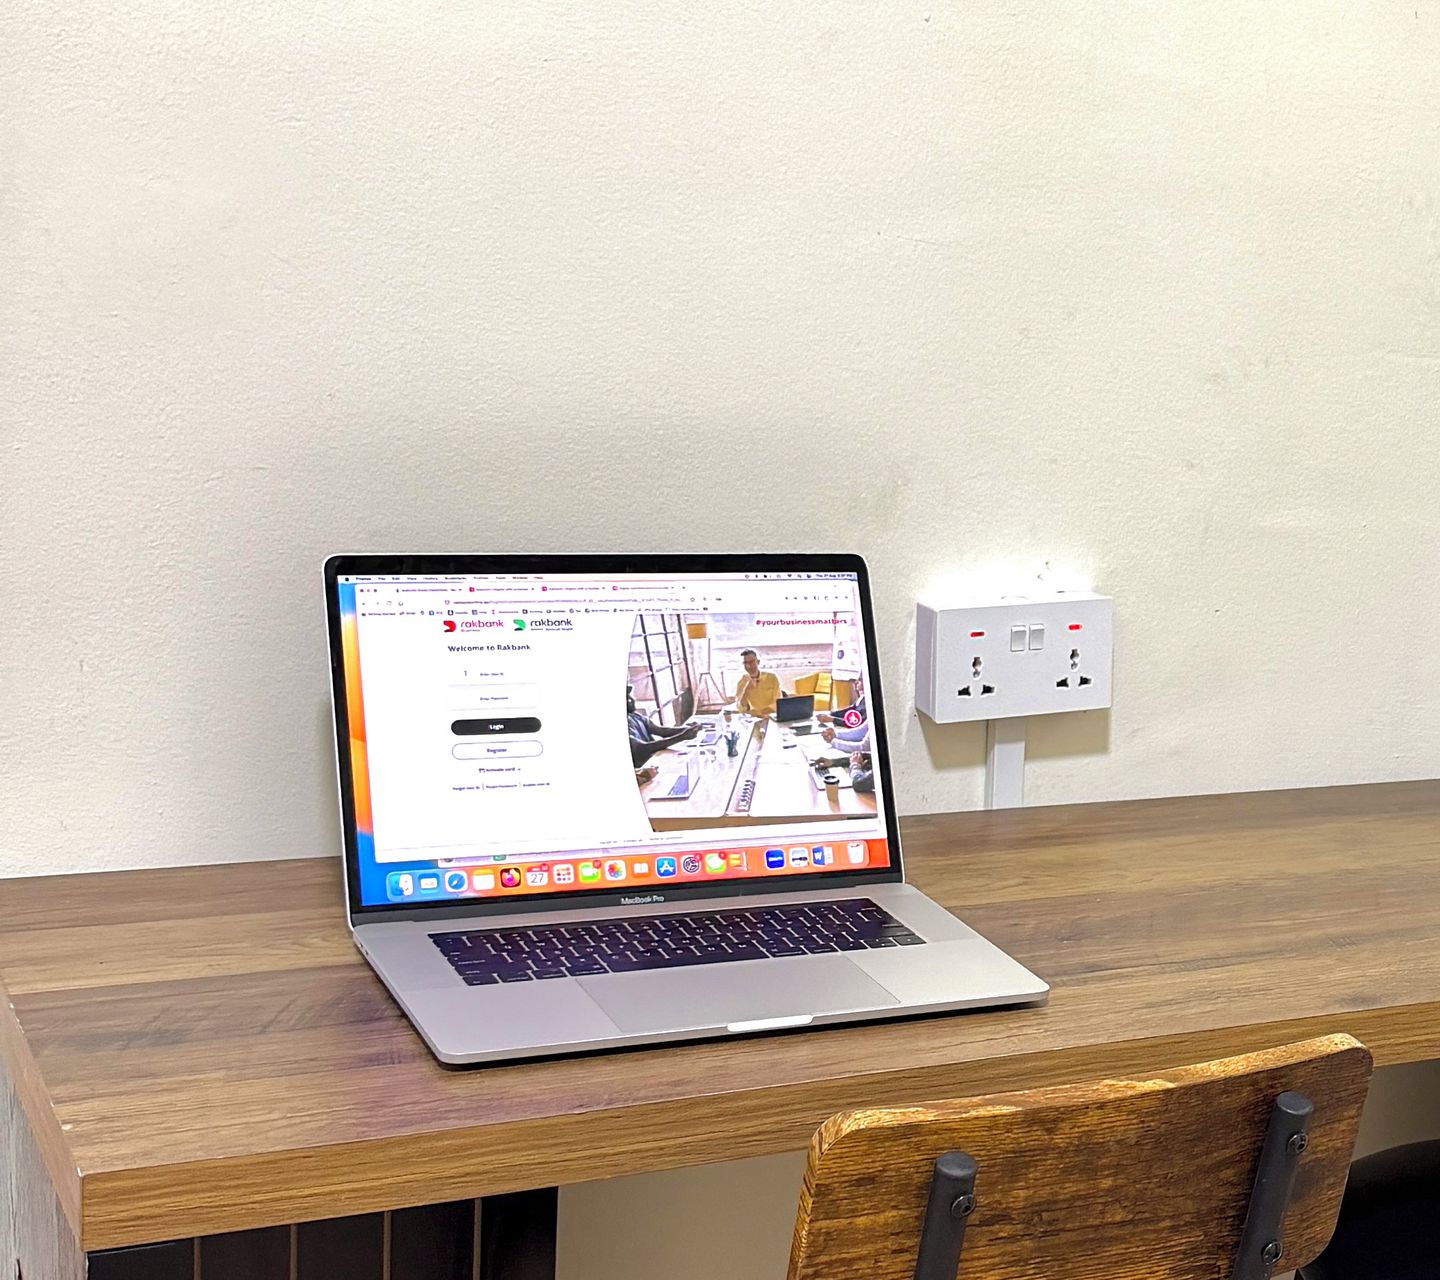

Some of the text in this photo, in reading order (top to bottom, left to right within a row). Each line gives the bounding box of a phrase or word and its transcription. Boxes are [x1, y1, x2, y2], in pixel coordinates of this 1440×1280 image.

[460, 620, 504, 628] rakbank
[530, 618, 573, 627] rakbank
[530, 872, 544, 884] 27
[621, 896, 652, 904] MacBook
